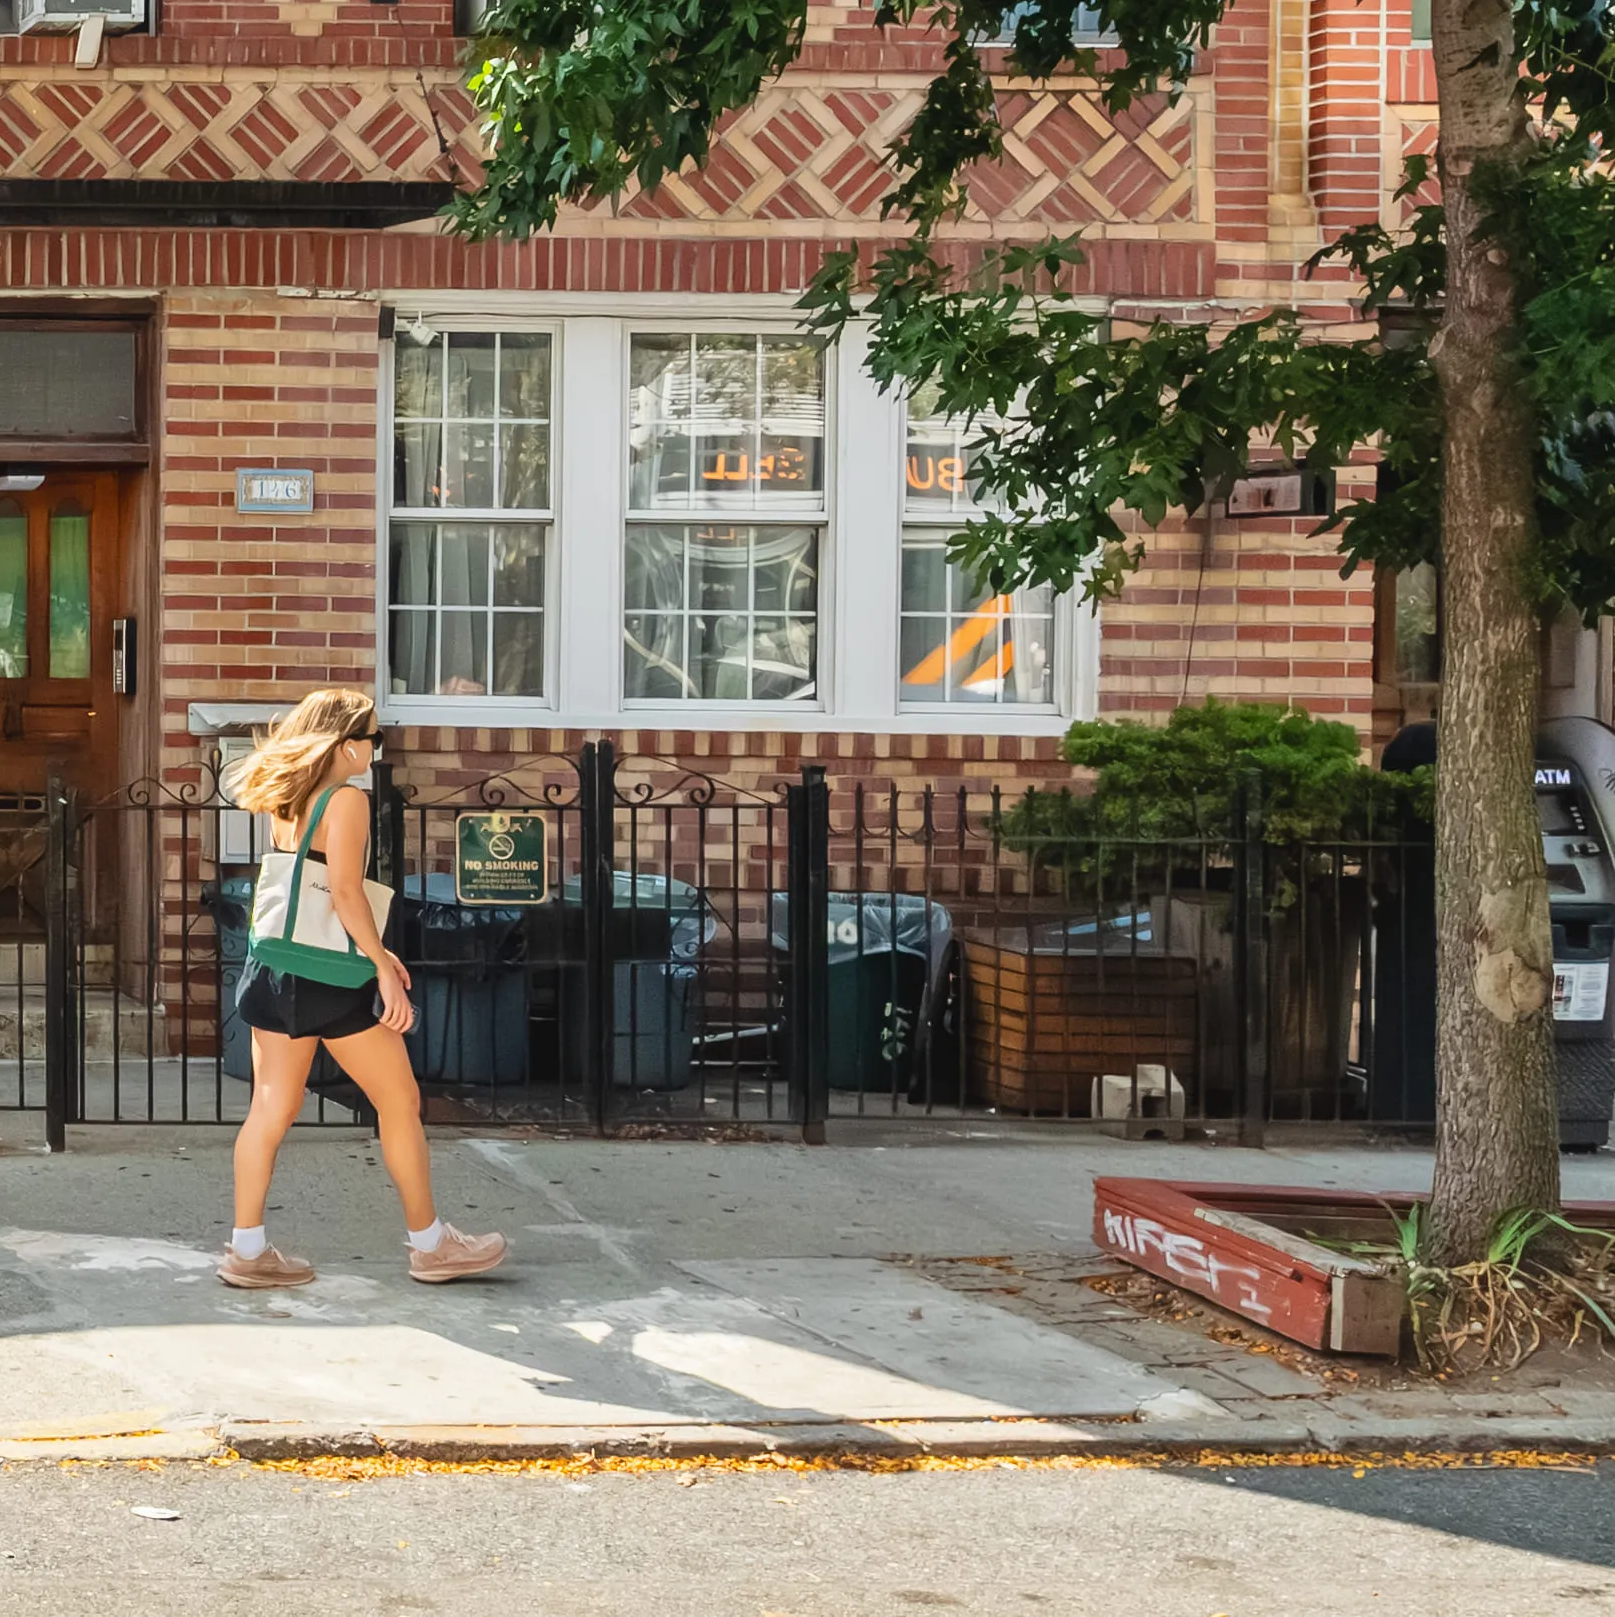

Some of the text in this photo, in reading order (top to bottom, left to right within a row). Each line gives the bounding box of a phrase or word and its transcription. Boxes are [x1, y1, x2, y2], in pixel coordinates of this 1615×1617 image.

[1534, 768, 1571, 785] ATM
[465, 860, 539, 871] NO SMOKING
